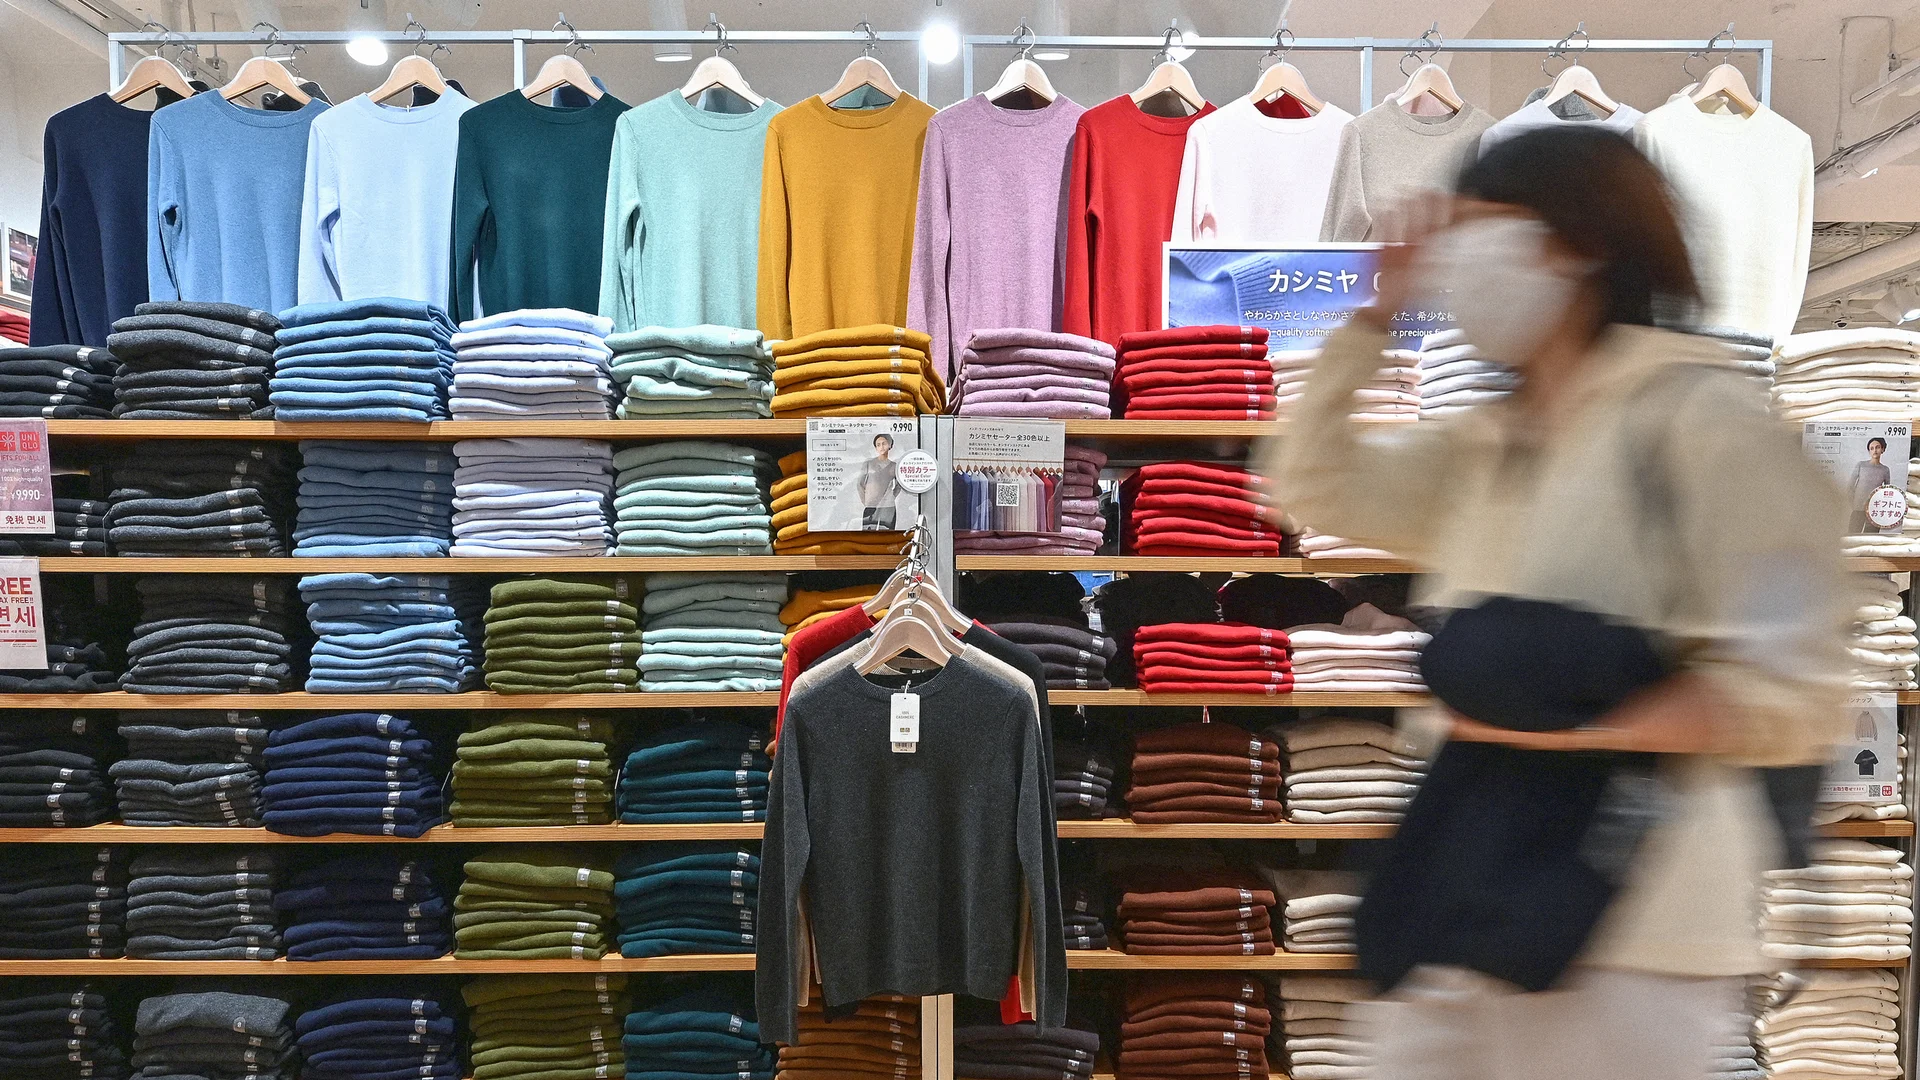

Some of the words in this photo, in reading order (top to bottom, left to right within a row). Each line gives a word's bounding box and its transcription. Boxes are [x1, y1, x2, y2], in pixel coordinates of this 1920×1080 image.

[1268, 269, 1359, 293] カシミヤ
[21, 433, 36, 441] UNI
[968, 433, 1051, 442] カシミヤセーター全30色以上
[22, 442, 38, 450] QLO
[899, 466, 936, 474] 特別カラー
[1873, 500, 1902, 509] ギフトに
[1870, 509, 1902, 518] おすすめ
[5, 515, 24, 525] 免税
[27, 515, 46, 525] 면세
